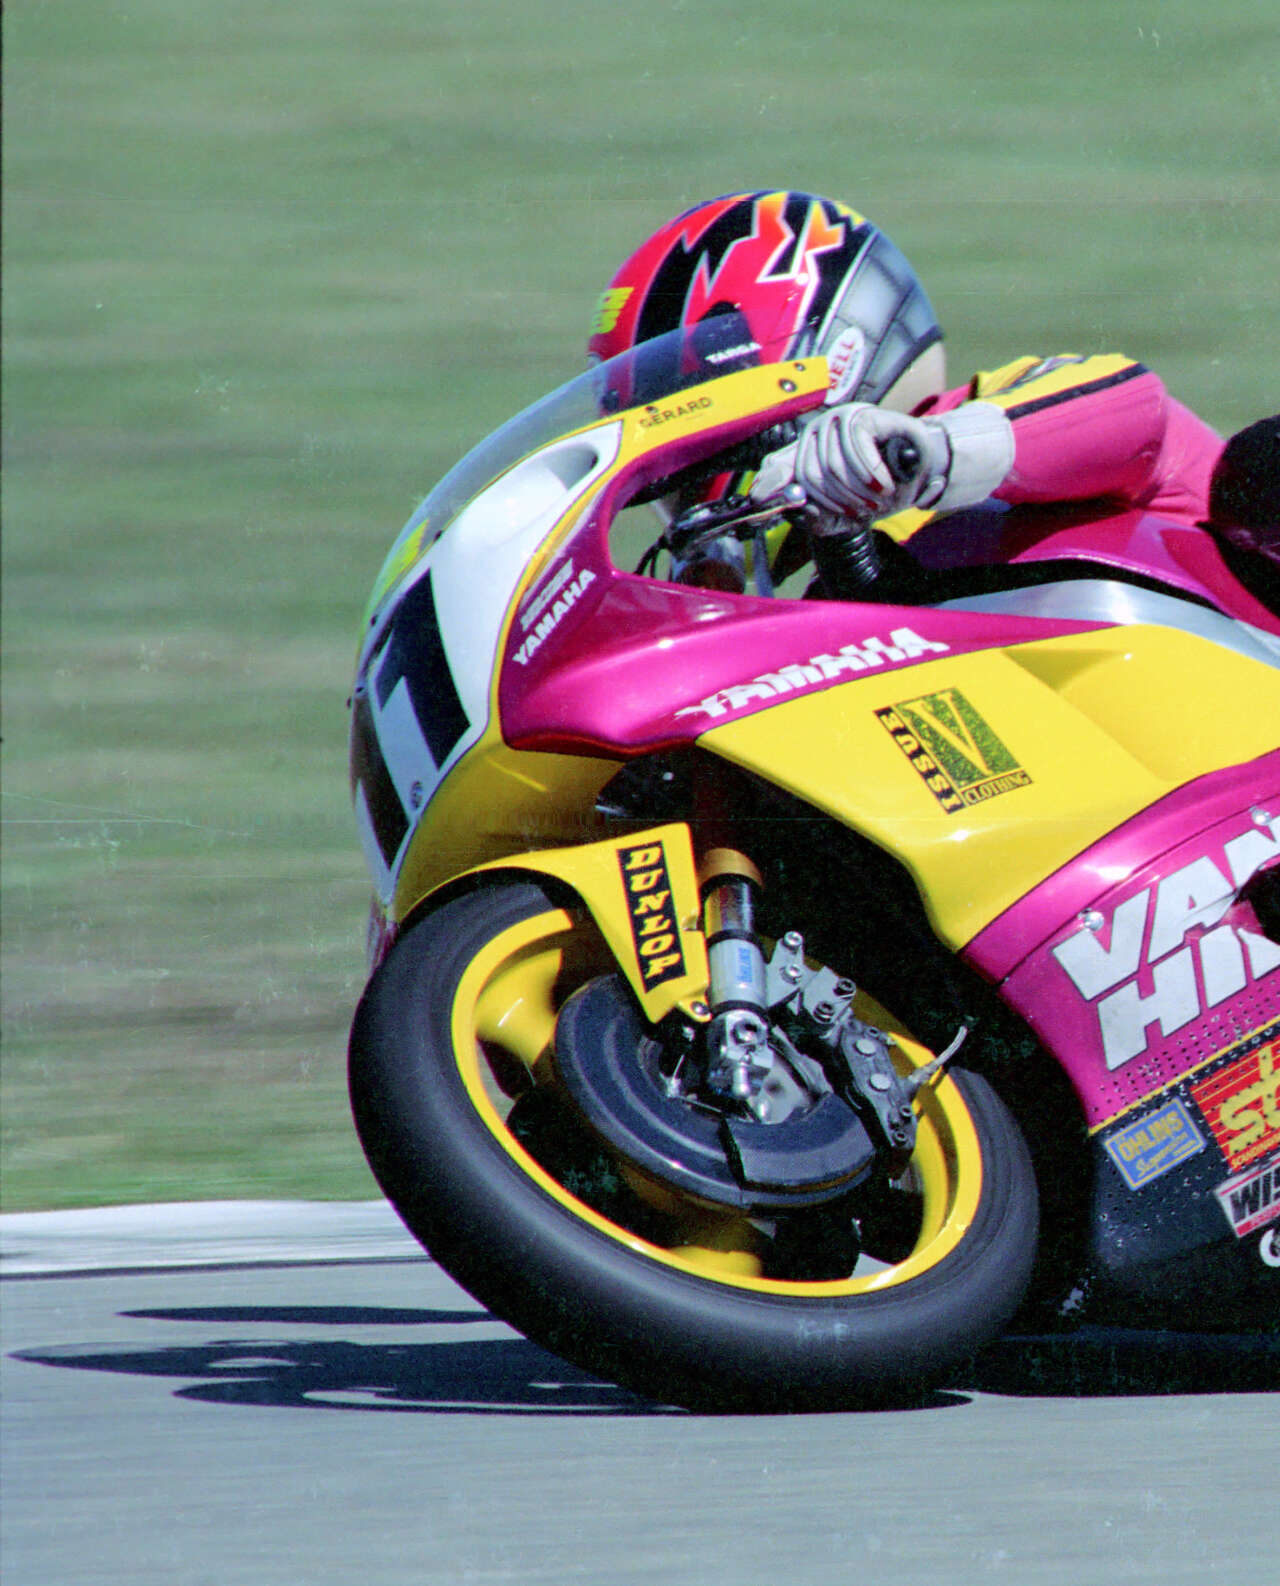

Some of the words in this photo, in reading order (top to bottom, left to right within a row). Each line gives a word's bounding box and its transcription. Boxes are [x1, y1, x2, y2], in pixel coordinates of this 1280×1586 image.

[638, 396, 713, 429] GERARD
[513, 570, 596, 665] YAMAHA
[675, 627, 951, 719] YAMAHA
[878, 708, 963, 812] ISSUE
[963, 771, 1032, 807] CLOTHING
[625, 844, 682, 979] DUNLOP
